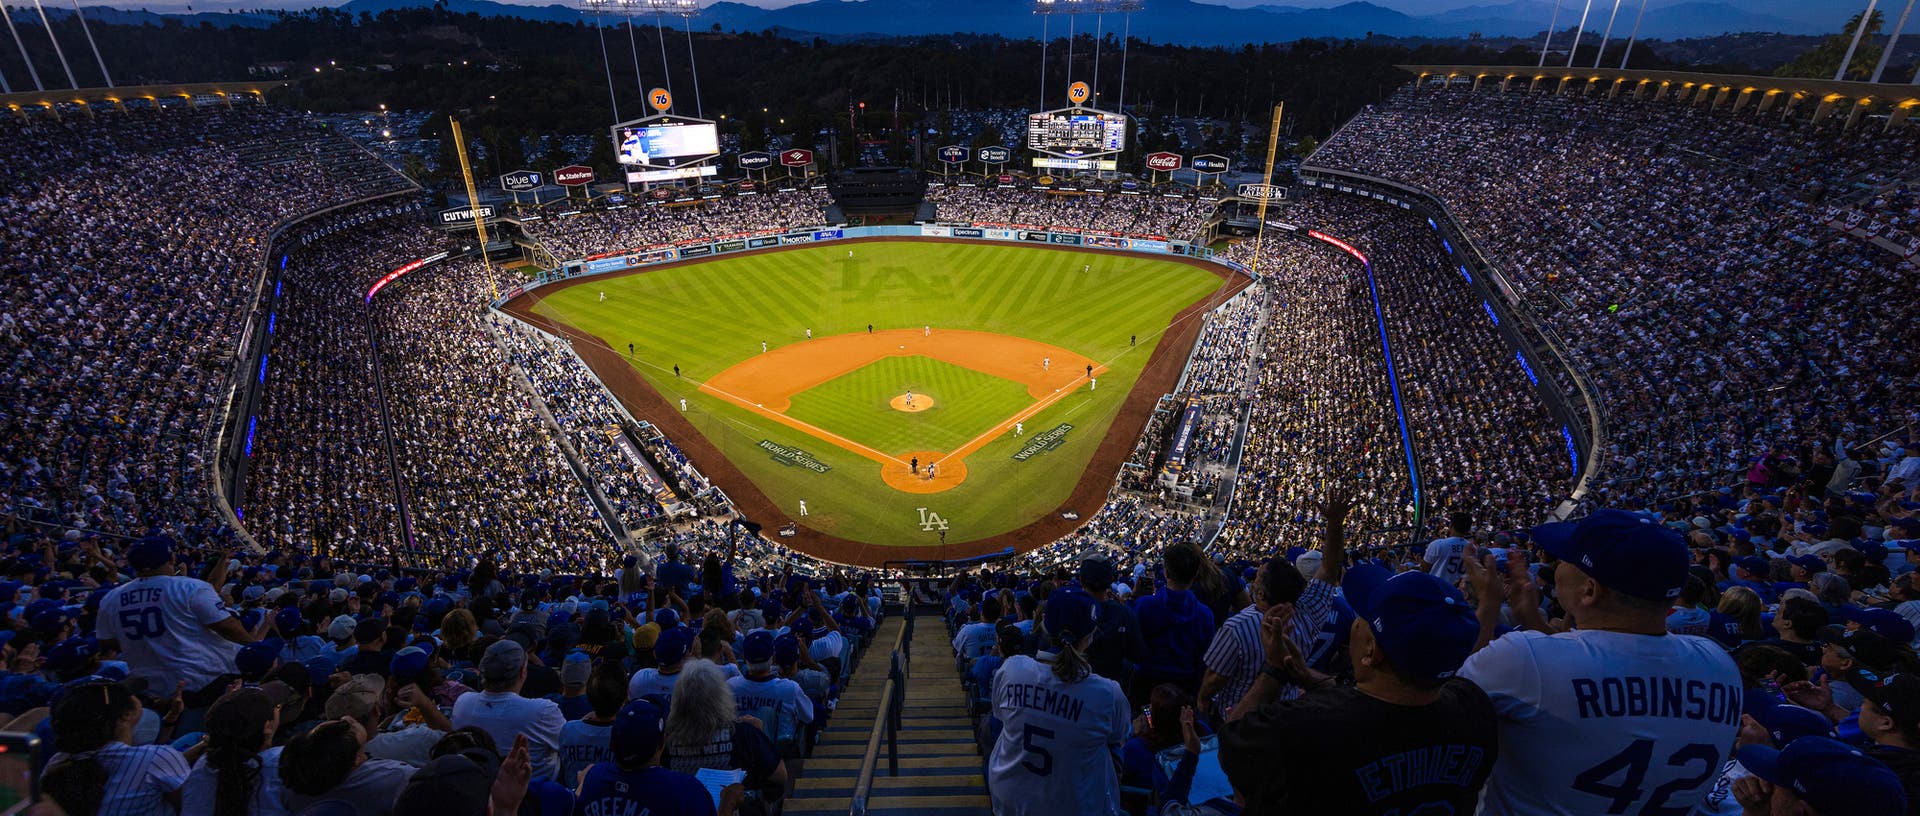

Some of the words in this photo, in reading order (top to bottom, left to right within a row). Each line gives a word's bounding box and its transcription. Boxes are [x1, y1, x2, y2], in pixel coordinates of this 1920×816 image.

[655, 94, 667, 105] 76
[1073, 87, 1085, 97] 76
[506, 175, 528, 185] blue
[443, 208, 491, 221] CUTWATER
[760, 440, 795, 458] WORLD
[792, 455, 828, 473] SERIES
[1014, 440, 1048, 460] WORLD
[1044, 424, 1072, 441] SERIES
[916, 507, 949, 531] LA
[120, 587, 162, 606] BETTS
[119, 606, 165, 640] 50
[1007, 684, 1084, 722] FREEMAN
[1572, 676, 1741, 727] ROBINSON
[1022, 723, 1055, 777] 5
[1352, 744, 1485, 804] ETHIER
[1571, 739, 1720, 816] 42
